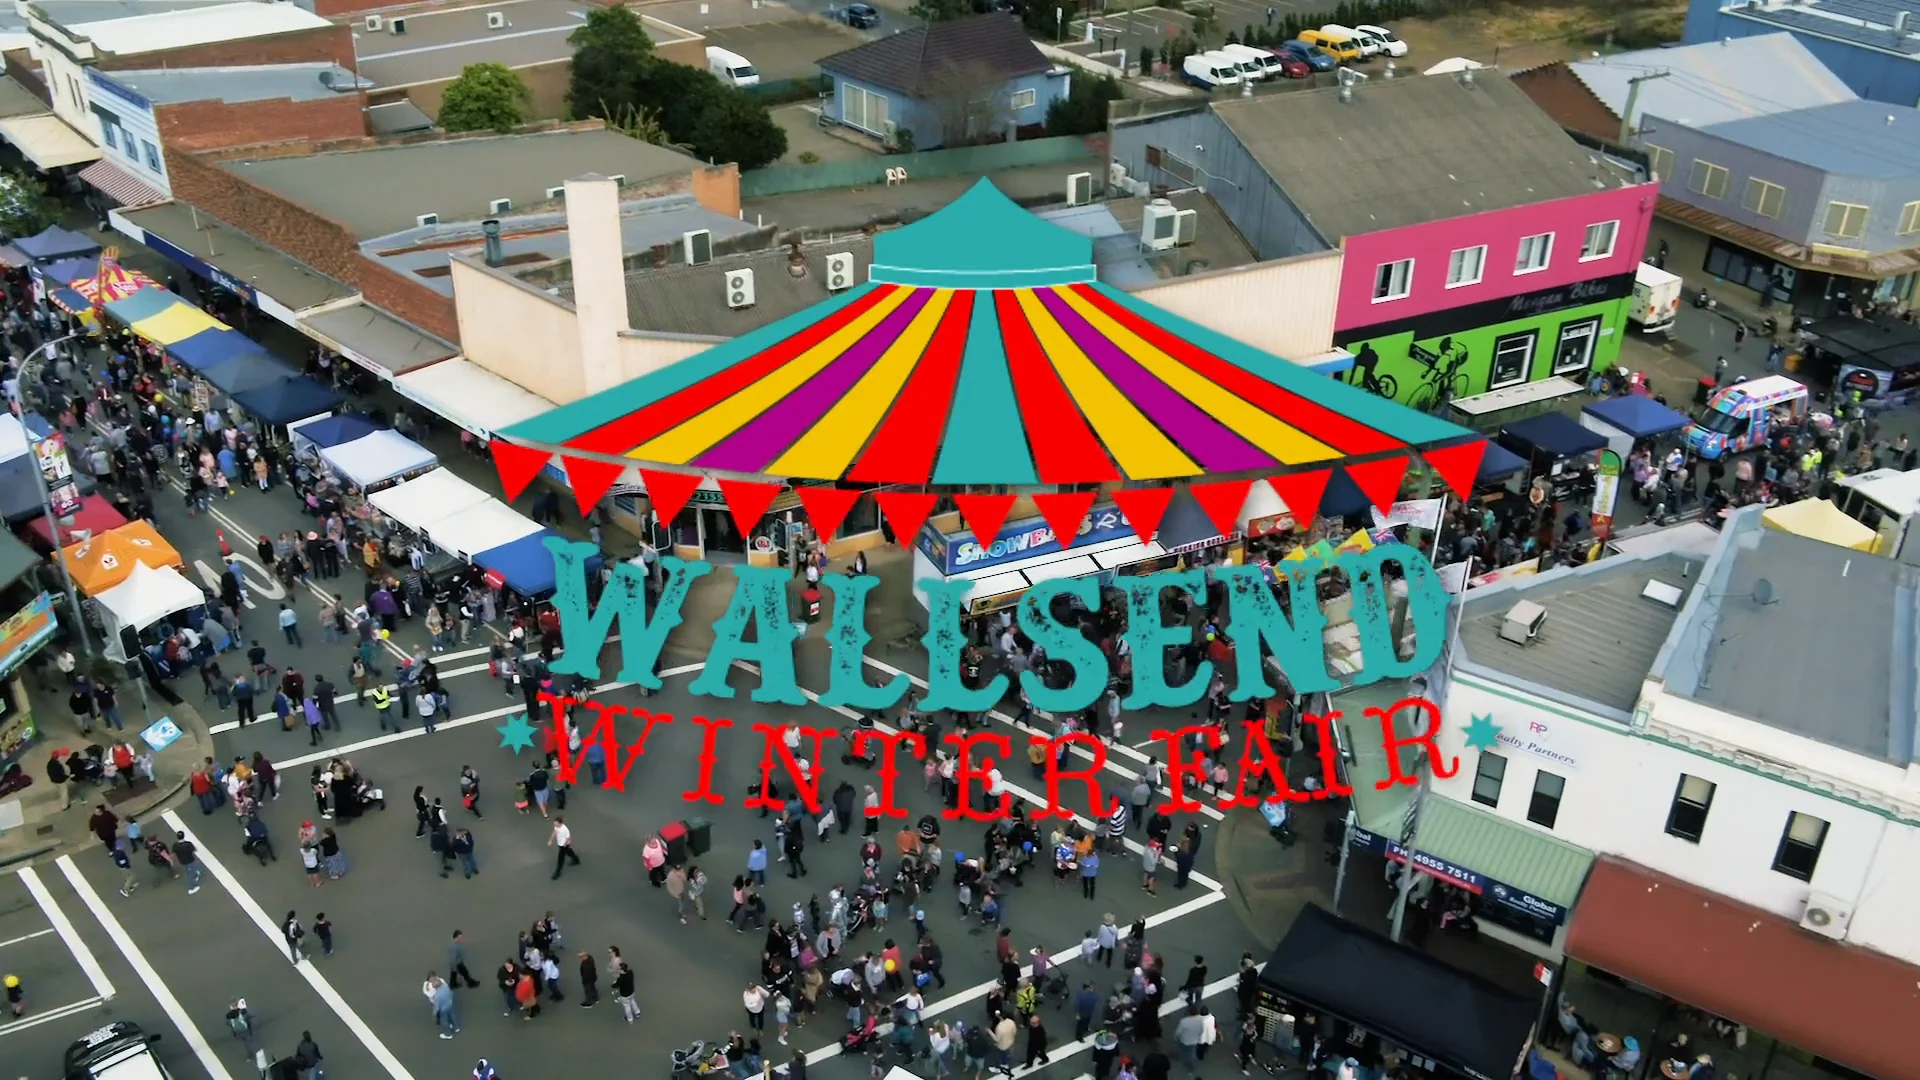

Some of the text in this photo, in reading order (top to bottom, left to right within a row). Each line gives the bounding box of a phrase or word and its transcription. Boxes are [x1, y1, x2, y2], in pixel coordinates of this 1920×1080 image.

[1507, 281, 1609, 313] Morgan Bikes
[1496, 732, 1576, 765] ealty Partners
[1414, 854, 1445, 871] 4955
[1447, 865, 1476, 884] 7511
[1522, 895, 1557, 914] Global
